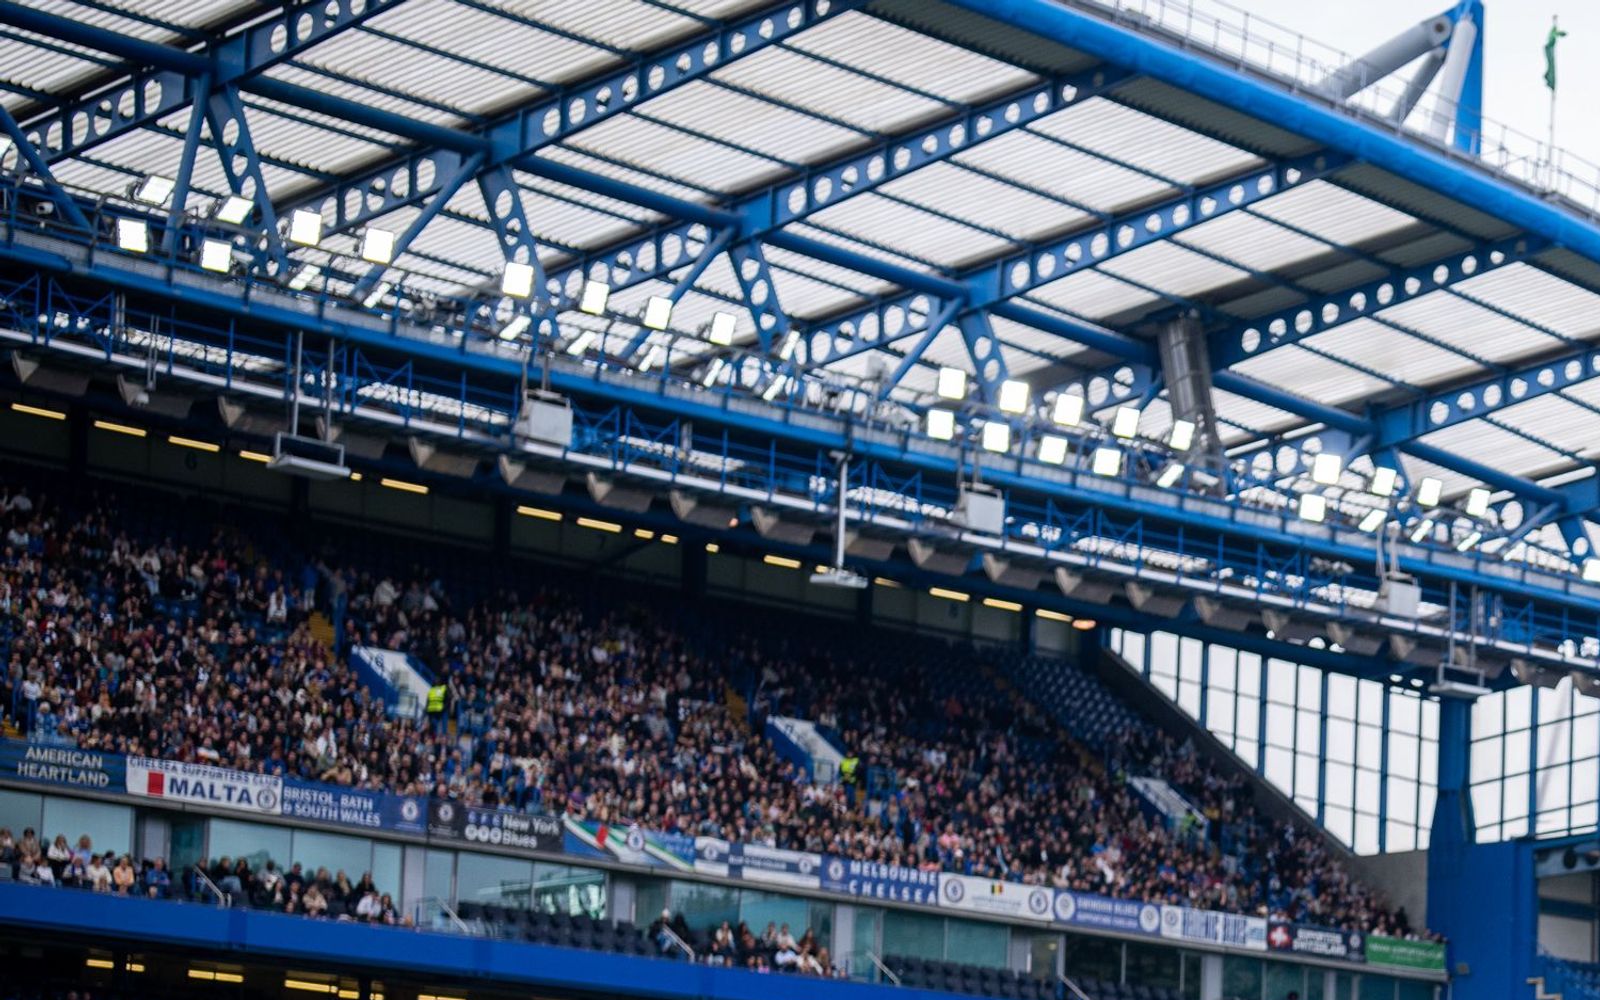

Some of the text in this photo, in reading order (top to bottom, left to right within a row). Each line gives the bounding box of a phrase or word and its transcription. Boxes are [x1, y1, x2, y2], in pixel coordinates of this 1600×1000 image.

[25, 746, 103, 770] AMERICAN
[129, 757, 178, 772] CHELSEA
[17, 761, 109, 788] HEARTLAND
[169, 777, 253, 805] MALTA
[341, 794, 373, 811] BATH
[294, 803, 338, 821] SOUTH
[340, 809, 380, 827] WALES
[502, 829, 538, 849] Blues
[850, 860, 937, 885] MELBOURNE
[849, 879, 937, 905] CHELSEA
